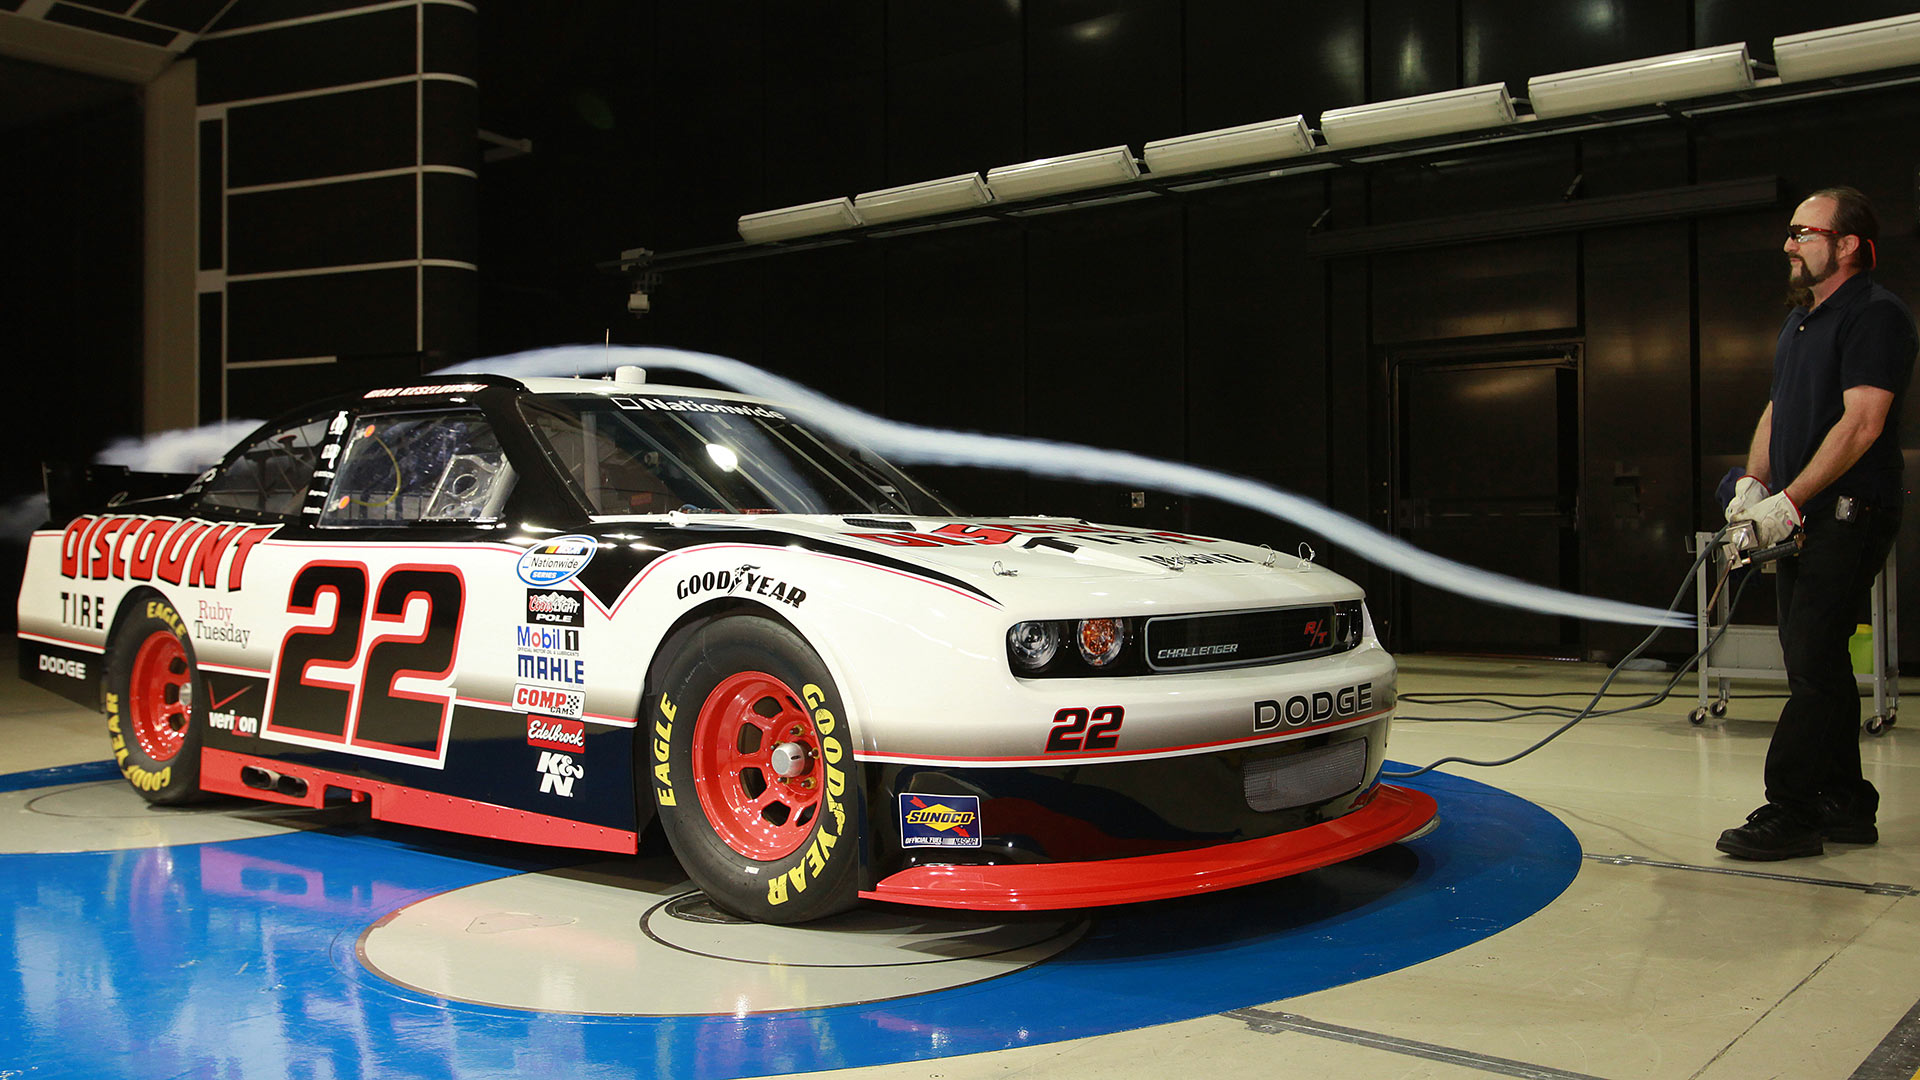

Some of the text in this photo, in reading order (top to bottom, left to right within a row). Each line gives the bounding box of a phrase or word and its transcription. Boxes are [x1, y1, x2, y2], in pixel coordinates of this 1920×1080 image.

[638, 398, 786, 420] Nationwide
[841, 523, 1221, 548] DISCOUT
[61, 514, 285, 592] DISCOUNT
[531, 557, 579, 569] Nationwide
[61, 591, 104, 630] TIRE
[198, 599, 232, 626] Ruby
[529, 595, 580, 613] Coors LIGHT
[147, 601, 187, 638] EAGLE
[536, 613, 573, 623] POLE
[195, 620, 250, 649] Tuesday
[517, 625, 578, 651] Mobil 1
[1304, 618, 1328, 647] R/T
[267, 559, 467, 760] 22
[1157, 643, 1239, 660] CHALLENGER
[39, 654, 86, 680] DODGE
[518, 654, 584, 684] MAHLE
[517, 688, 567, 708] COMP
[550, 706, 575, 716] CAMS
[1253, 682, 1372, 732] DODGE
[209, 709, 258, 737] verizon
[528, 720, 584, 747] Edelbrock
[1043, 704, 1126, 754] 22
[653, 693, 679, 807] EAGLE
[909, 811, 972, 824] SUNOCO
